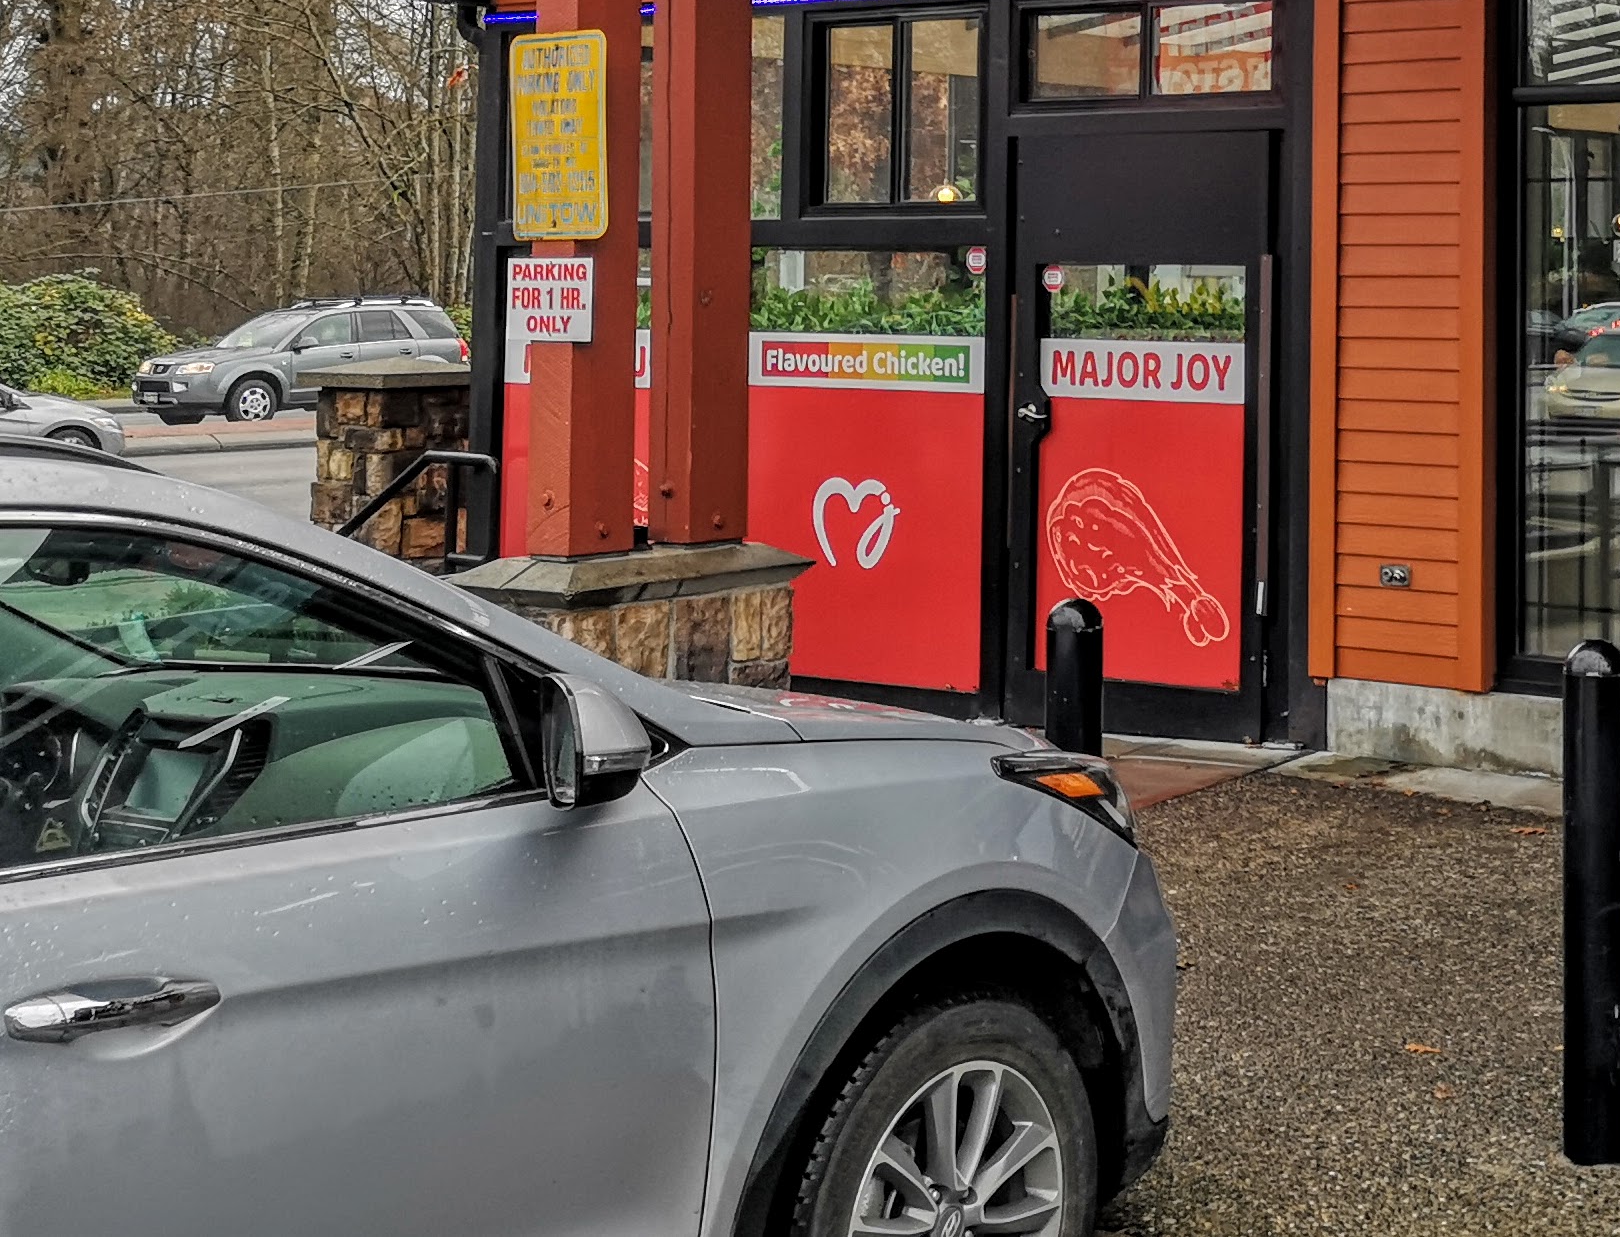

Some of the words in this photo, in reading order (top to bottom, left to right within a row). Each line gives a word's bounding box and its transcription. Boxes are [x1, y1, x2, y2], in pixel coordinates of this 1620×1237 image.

[512, 263, 587, 282] PARKING
[512, 287, 542, 311] FOR
[546, 288, 554, 310] 1
[560, 287, 586, 311] HR.
[526, 315, 572, 334] ONLY
[766, 348, 868, 374] Flavoured
[873, 350, 965, 377] Chicken!
[1051, 350, 1162, 389] MAJOR
[1171, 354, 1232, 391] JOY
